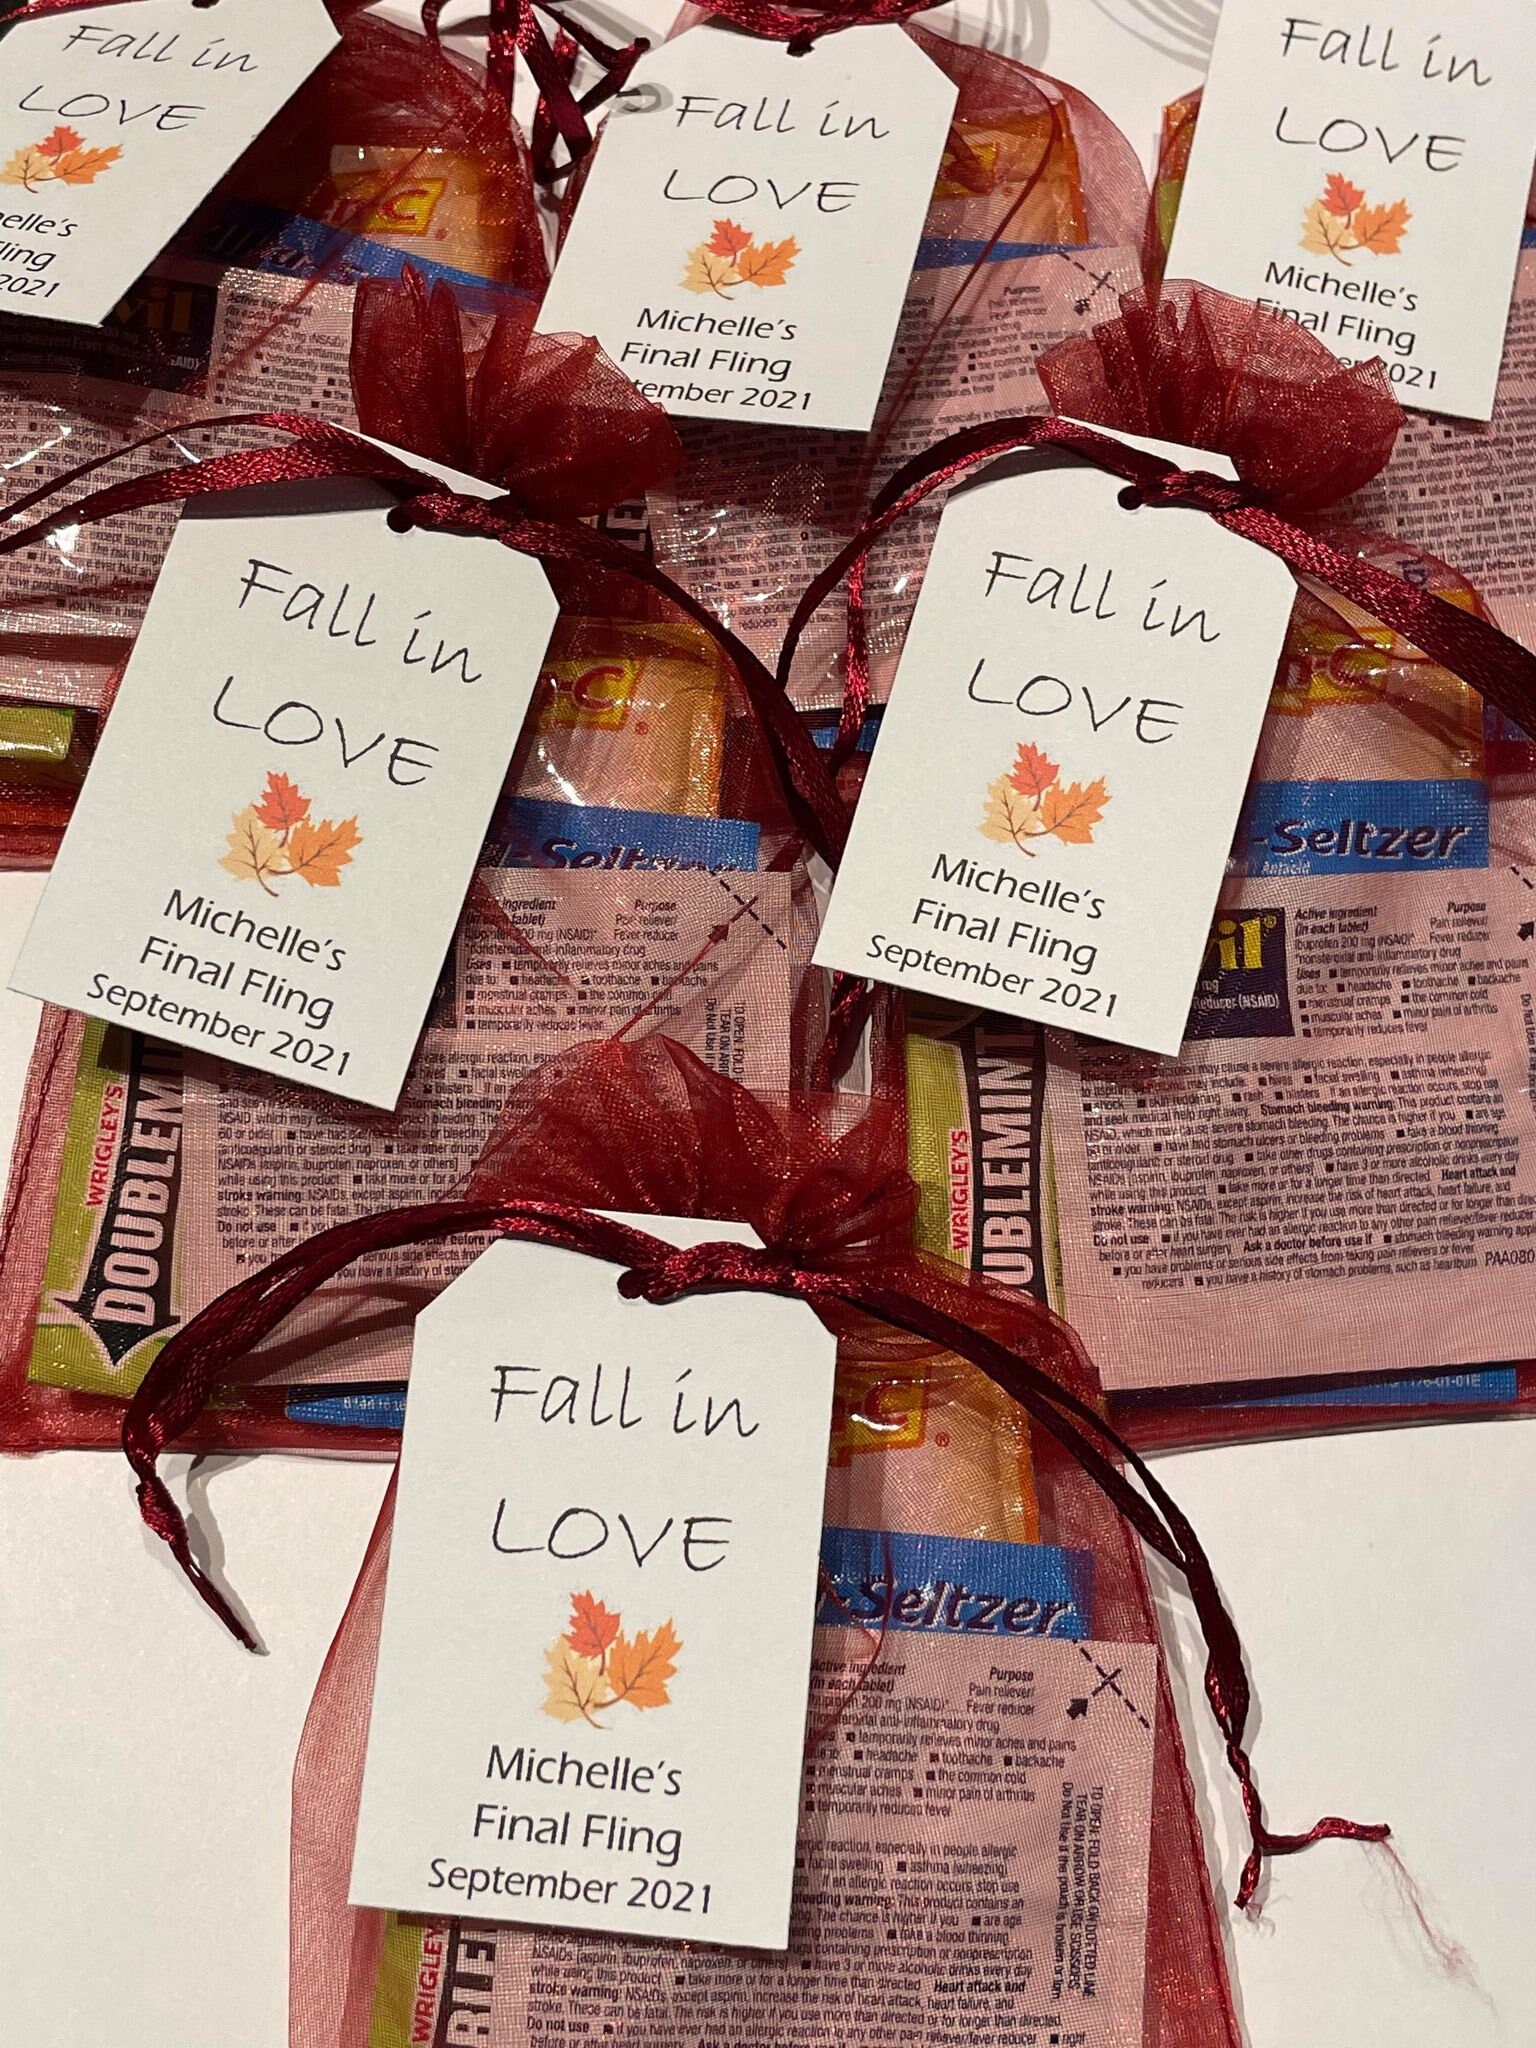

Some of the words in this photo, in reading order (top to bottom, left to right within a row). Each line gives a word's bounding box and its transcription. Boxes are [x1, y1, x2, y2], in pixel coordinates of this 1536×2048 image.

[64, 26, 179, 62] Fall
[192, 39, 257, 71] in
[1282, 19, 1395, 70] Fall
[1424, 35, 1492, 86] in
[19, 86, 204, 130] LOVE
[677, 96, 794, 132] Fall
[820, 101, 889, 138] in
[1276, 106, 1466, 172] LOVE
[664, 170, 859, 212] LOVE
[0, 212, 77, 236] elle's
[0, 241, 56, 271] ling
[1264, 261, 1418, 311] Michelle's
[637, 308, 796, 340] Michelle's
[1338, 315, 1415, 356] Fling
[621, 342, 700, 368] Final
[709, 350, 791, 382] Fling
[1383, 361, 1436, 390] 021
[632, 378, 734, 404] tember
[740, 388, 810, 410] 2021
[239, 559, 376, 646] Fall
[404, 610, 481, 683] in
[986, 552, 1115, 619] Fall
[1143, 580, 1220, 642] in
[969, 659, 1183, 743] LOVE
[214, 676, 439, 786] LOVE
[1252, 819, 1473, 860] -Seltzer
[931, 854, 1105, 920] Michelle's
[1448, 902, 1486, 914] Purpose
[162, 889, 347, 972] Michelle's
[913, 899, 1000, 942] Final
[1008, 922, 1097, 975] Fling
[140, 936, 235, 989] Final
[241, 969, 333, 1029] Fling
[866, 934, 1034, 997] September
[1040, 978, 1116, 1017] 2021
[87, 973, 266, 1050] September
[270, 1031, 349, 1075] 2021
[87, 1085, 123, 1207] WRIGLEY'S
[974, 1027, 1035, 1296] UBLEMINT
[1442, 1169, 1467, 1180] Heart
[1470, 1167, 1497, 1179] attack
[1500, 1166, 1516, 1177] and
[92, 1037, 184, 1326] DOUBLEMI
[952, 1130, 969, 1250] WRIGLEY'S
[1091, 1205, 1124, 1216] stroke
[491, 1364, 641, 1429] Fall
[674, 1369, 759, 1437] in
[493, 1499, 732, 1571] LOVE
[848, 1576, 1074, 1637] Seltzer
[989, 1667, 1034, 1682] Purpose
[487, 1746, 682, 1796] Michelle's
[1062, 1782, 1073, 1797] Do
[474, 1804, 569, 1845] Final
[583, 1815, 681, 1867] Fling
[1088, 1840, 1100, 1869] FOLD
[429, 1859, 617, 1903] September
[627, 1878, 710, 1913] 2021
[412, 1920, 447, 2043] WRIGLEY
